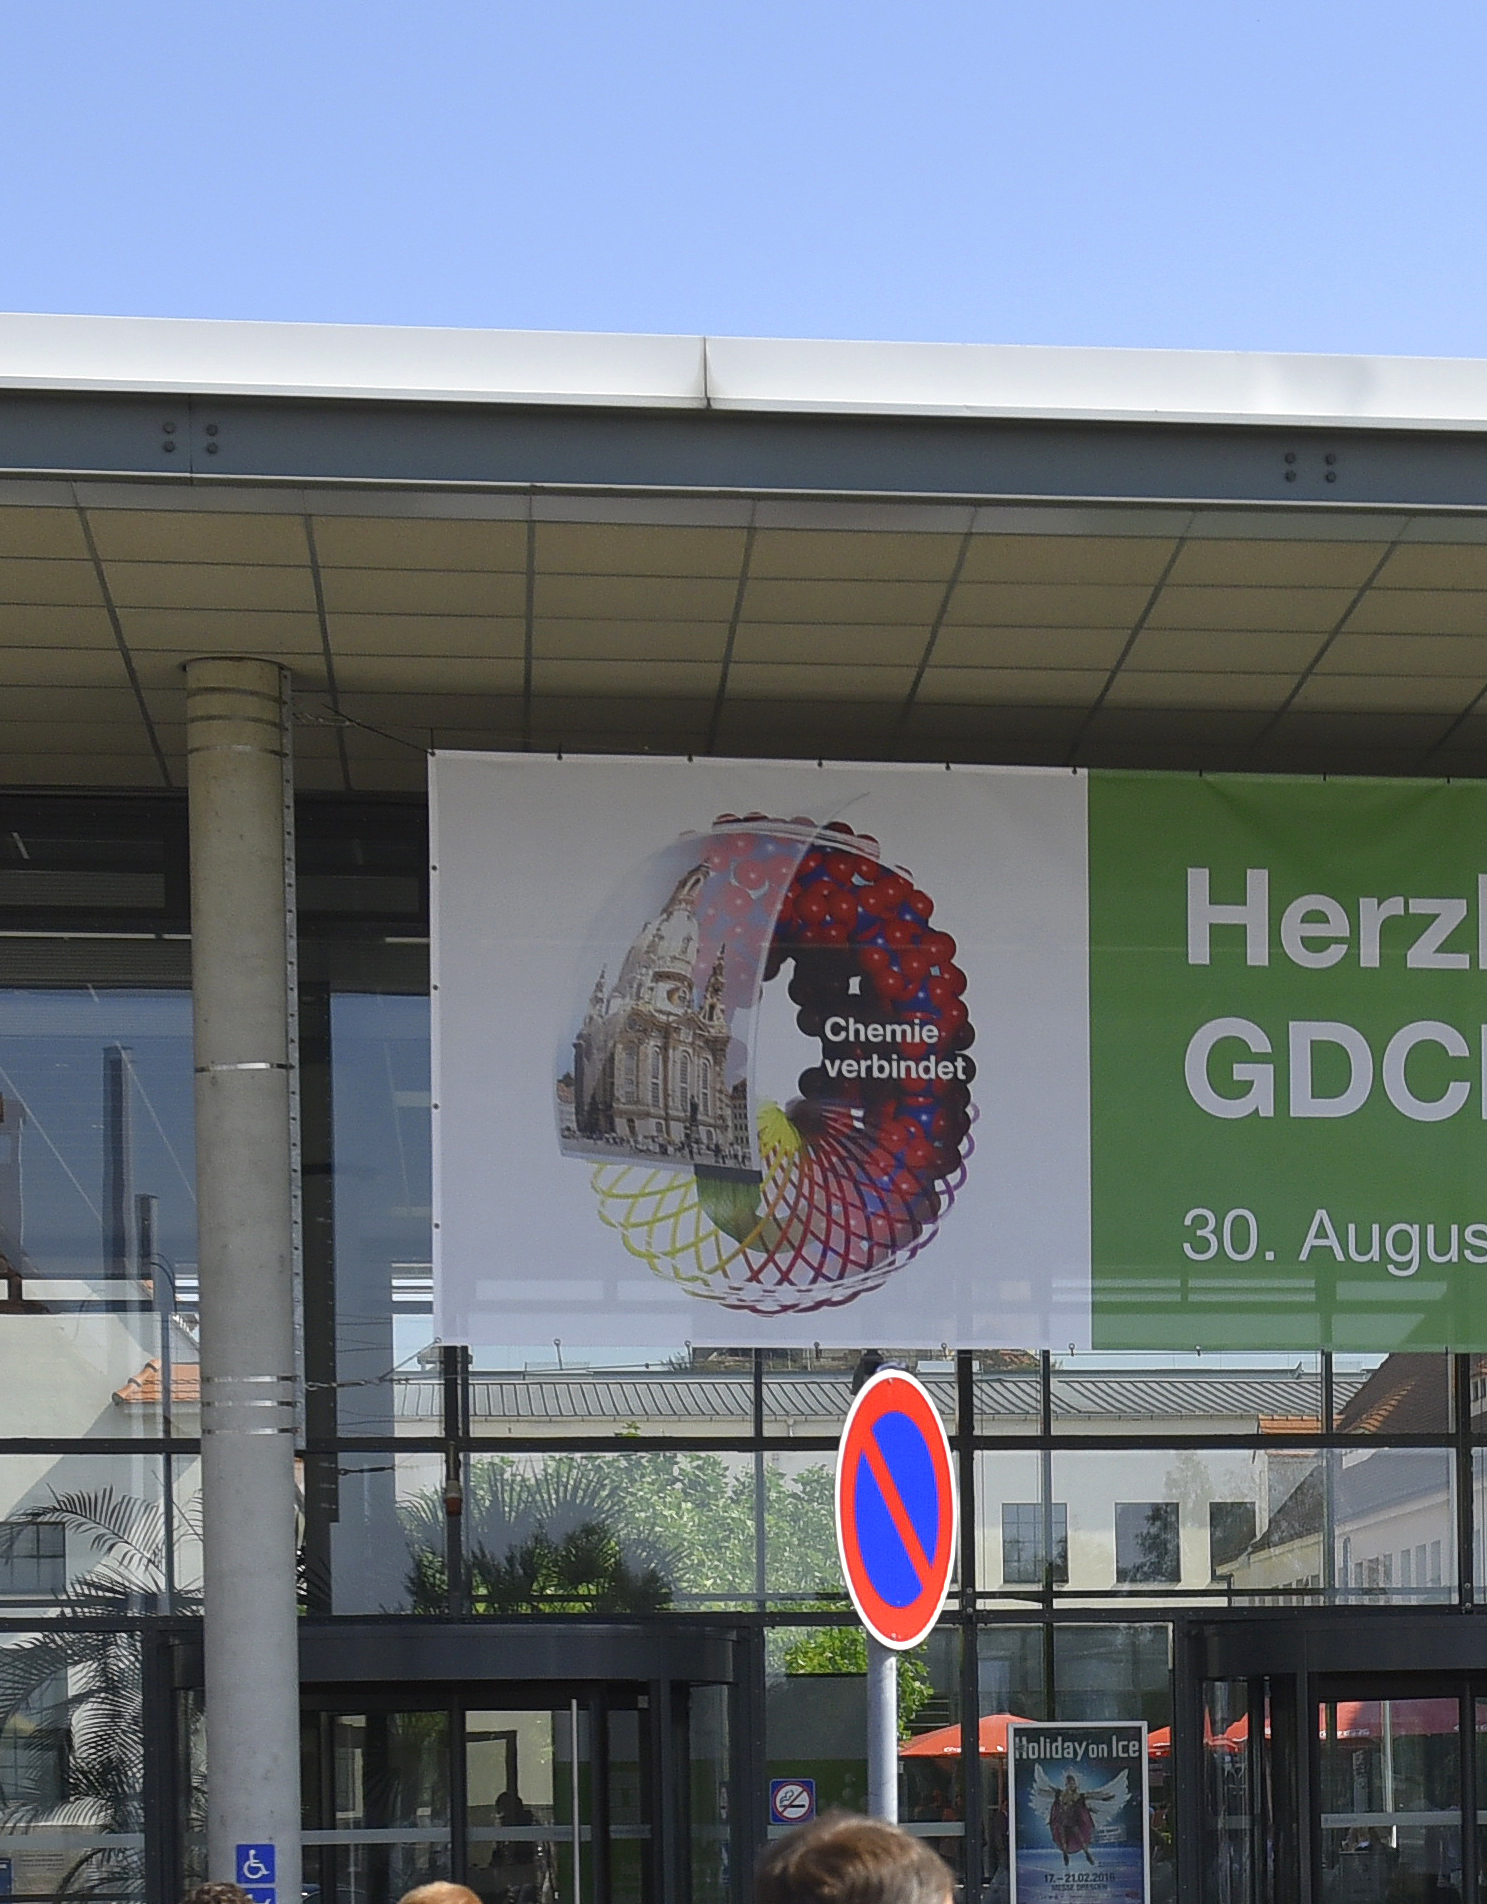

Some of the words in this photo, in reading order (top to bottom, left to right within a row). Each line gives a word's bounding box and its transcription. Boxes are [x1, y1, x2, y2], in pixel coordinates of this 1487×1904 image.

[824, 1016, 940, 1044] Chemie
[824, 1053, 967, 1080] verbindet
[1182, 1207, 1276, 1263] 30.
[1015, 1736, 1087, 1761] Holiday
[1088, 1743, 1108, 1758] on
[1112, 1735, 1140, 1758] Ice
